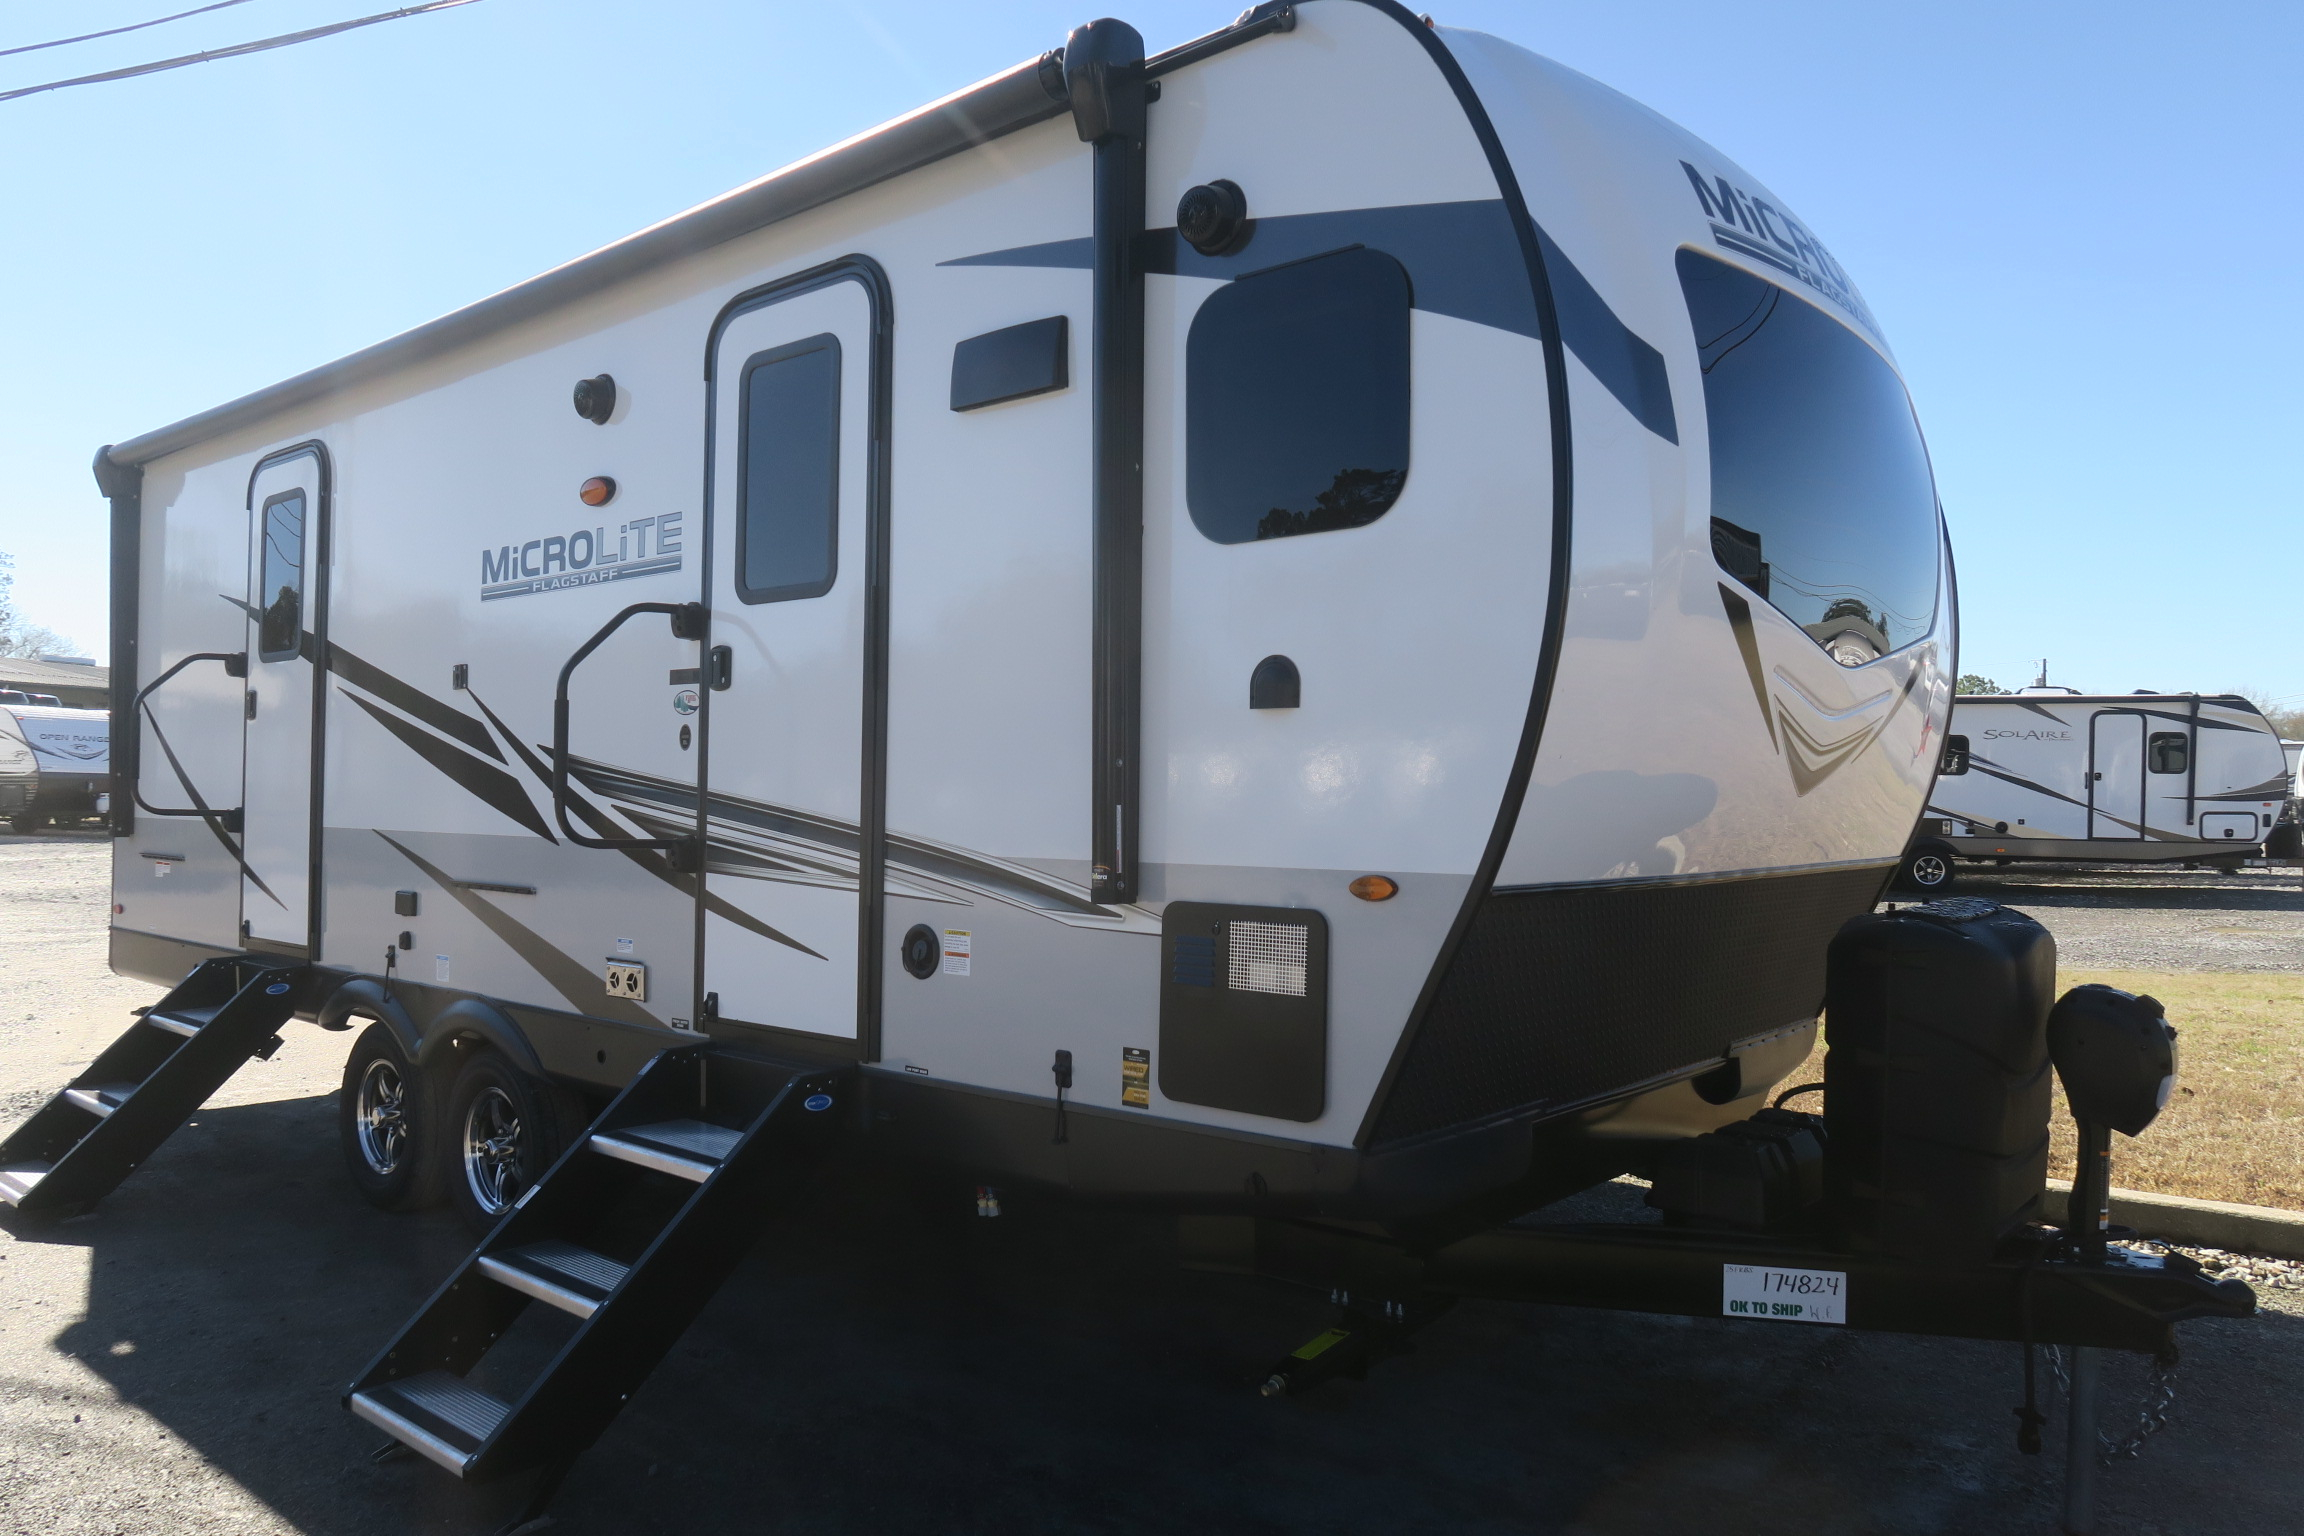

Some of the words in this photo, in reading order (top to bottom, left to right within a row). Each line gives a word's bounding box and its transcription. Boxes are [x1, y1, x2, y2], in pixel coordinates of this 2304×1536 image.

[532, 568, 619, 593] FLAGSTAFF
[40, 733, 69, 741] OPEN
[1763, 1272, 1839, 1296] 174824
[1729, 1299, 1749, 1314] OK
[1752, 1301, 1768, 1315] TO
[1771, 1303, 1803, 1317] SHIP
